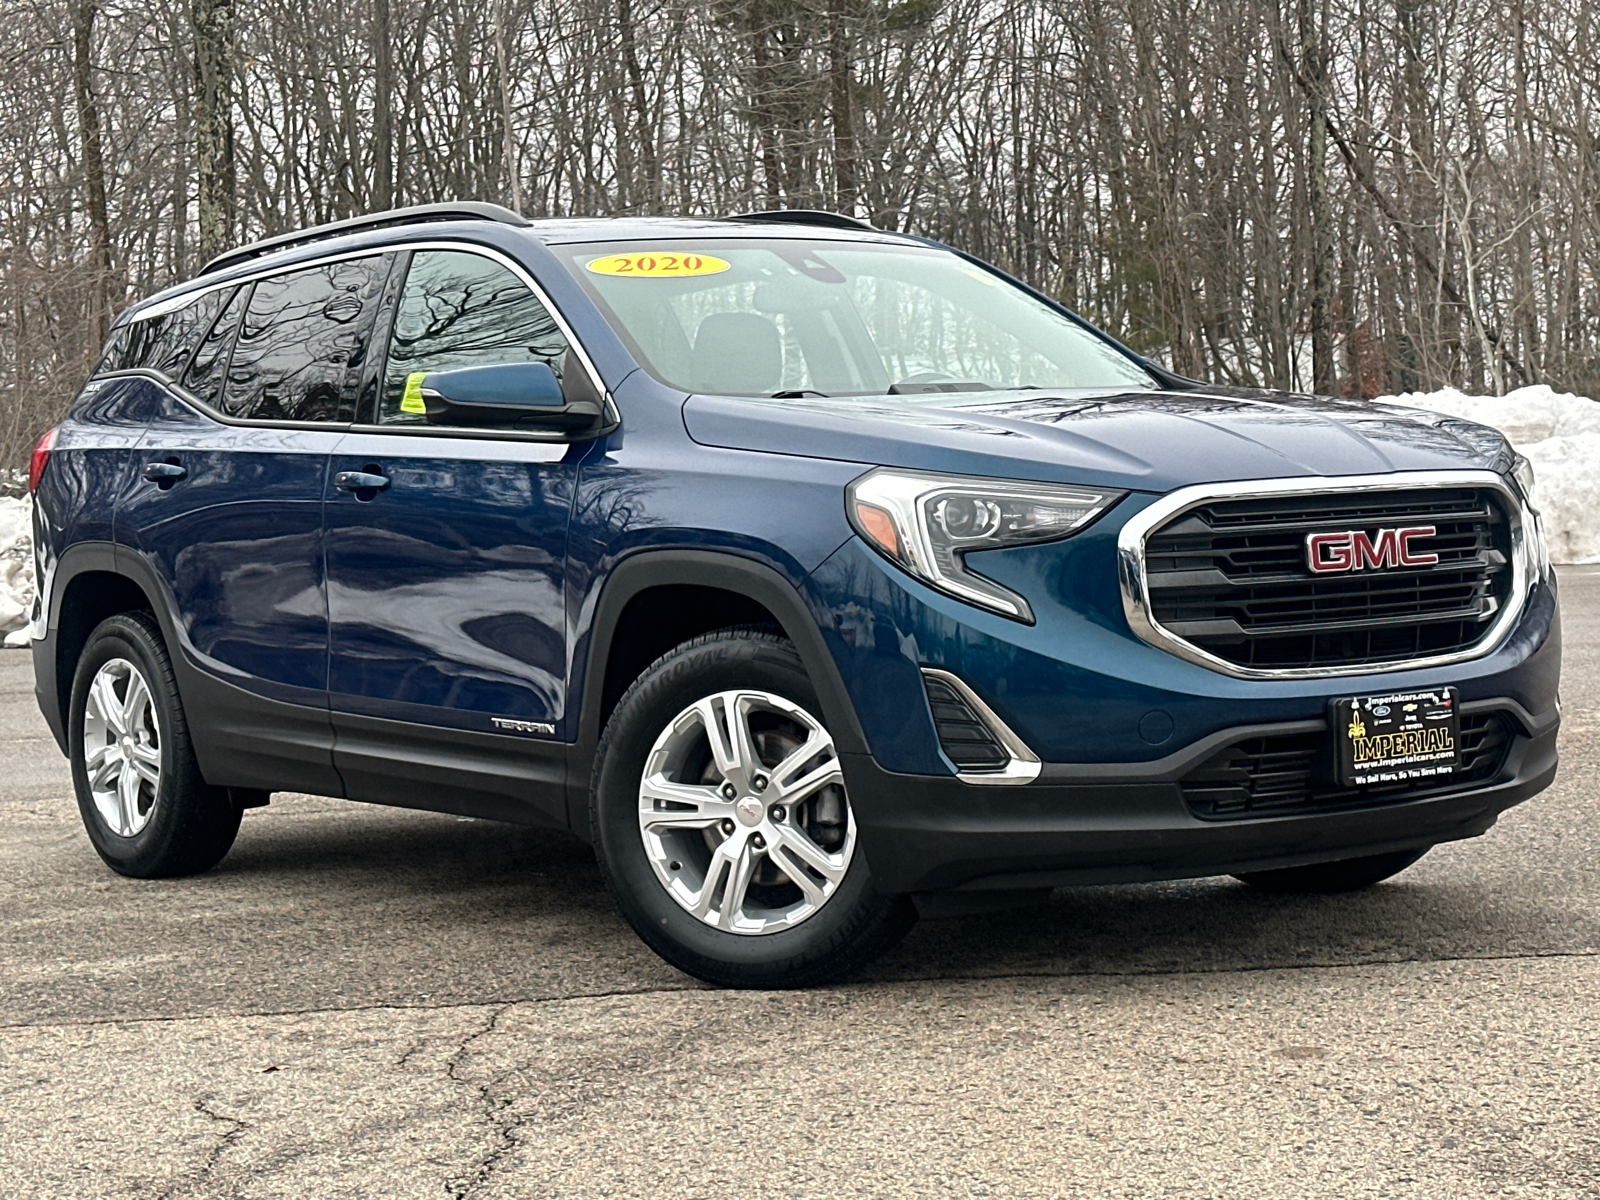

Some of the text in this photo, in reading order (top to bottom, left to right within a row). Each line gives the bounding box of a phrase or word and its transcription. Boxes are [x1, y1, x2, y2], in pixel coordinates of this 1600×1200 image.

[614, 256, 702, 272] 2020
[1306, 525, 1439, 573] GMC
[491, 717, 555, 735] TERRAIN
[1353, 727, 1454, 762] IMPERIAL
[1354, 751, 1454, 769] www.imperialcars.com
[1355, 776, 1366, 785] We
[1399, 770, 1407, 779] So
[1408, 768, 1421, 778] You
